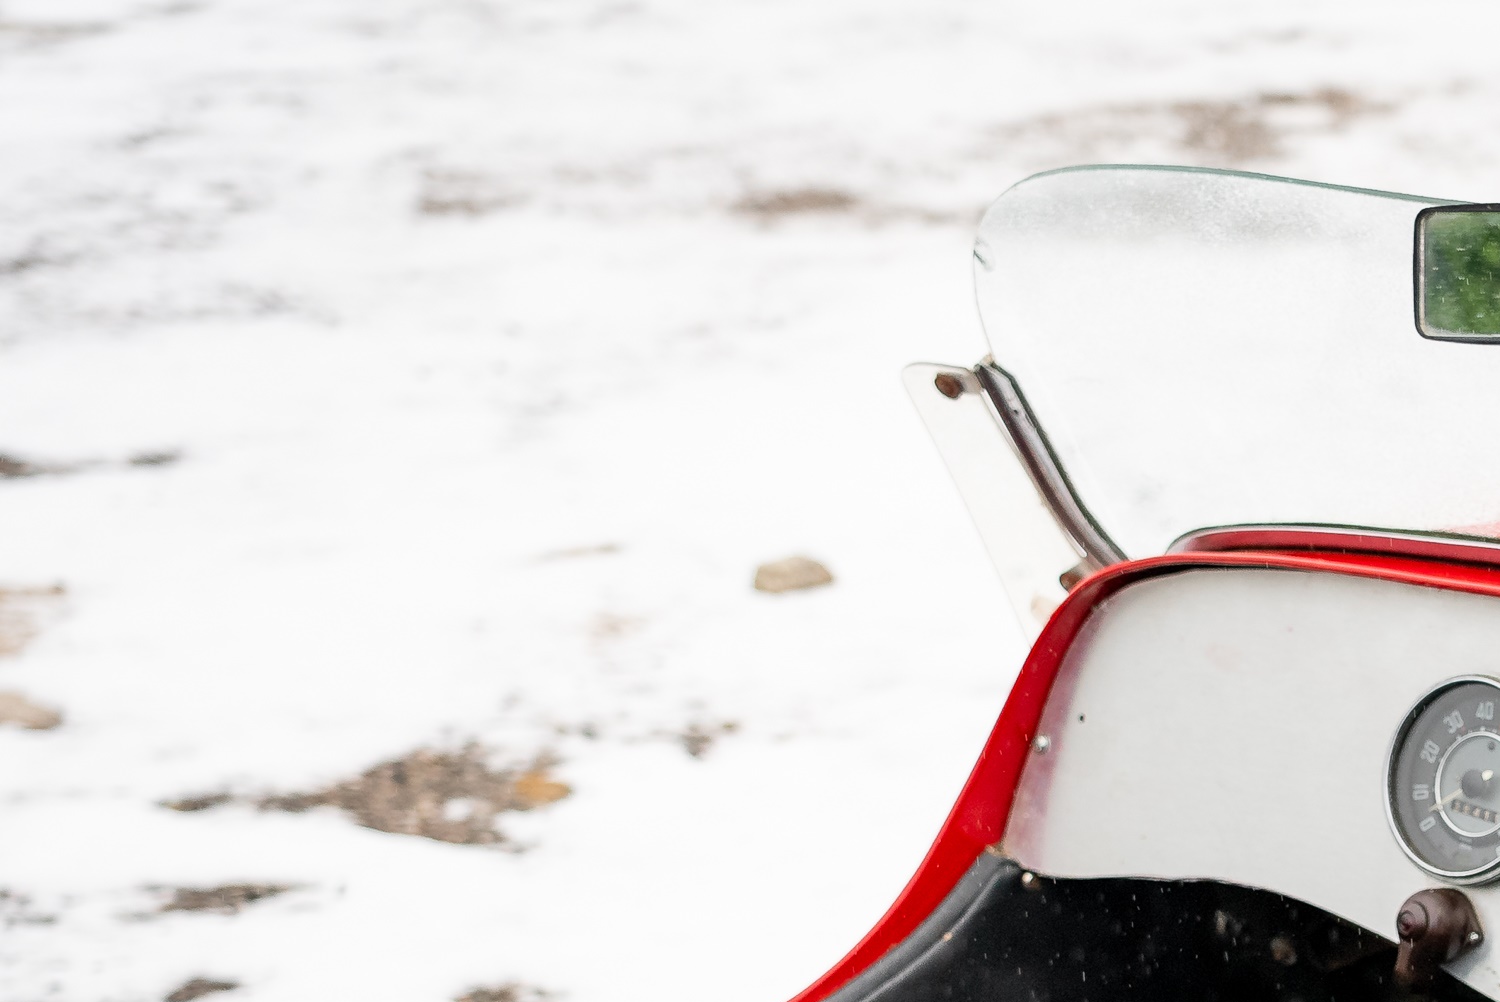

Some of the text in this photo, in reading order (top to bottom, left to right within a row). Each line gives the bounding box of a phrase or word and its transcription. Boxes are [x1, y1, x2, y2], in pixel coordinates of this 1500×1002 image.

[1443, 709, 1464, 734] 30
[1476, 701, 1495, 720] 40
[1420, 740, 1440, 764] 20
